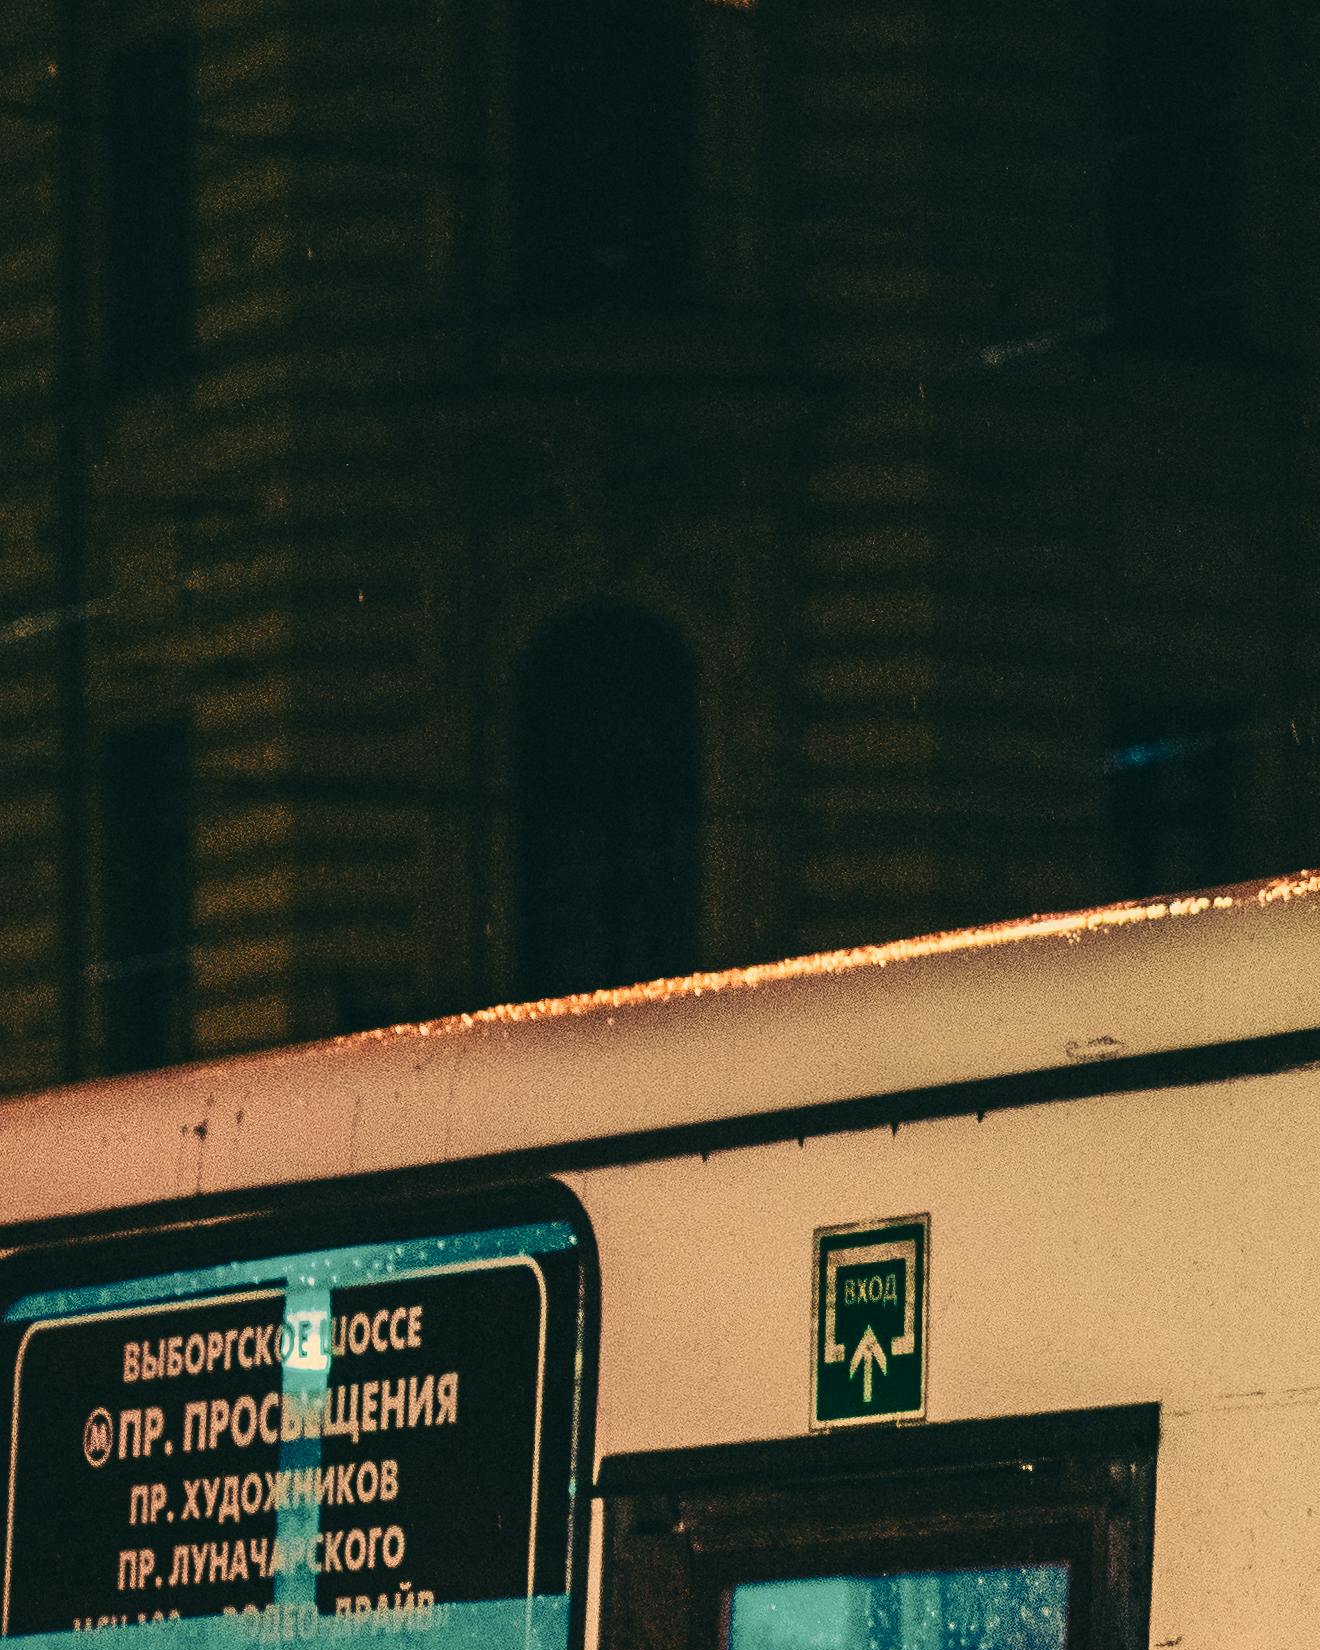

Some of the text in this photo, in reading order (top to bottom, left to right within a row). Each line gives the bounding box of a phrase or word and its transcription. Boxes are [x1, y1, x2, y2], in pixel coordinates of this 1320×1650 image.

[844, 1274, 898, 1307] ВХОД
[122, 1305, 424, 1384] ВЫБОРГСКОЕ ШОССЕ
[117, 1405, 173, 1460] ПР.
[182, 1371, 459, 1452] ПРОСВЕЩЕНИЯ
[128, 1459, 400, 1525] ПР. ХУДОЖНИКОВ
[117, 1525, 406, 1590] ПР. ЛУНАЧАРСКОГО
